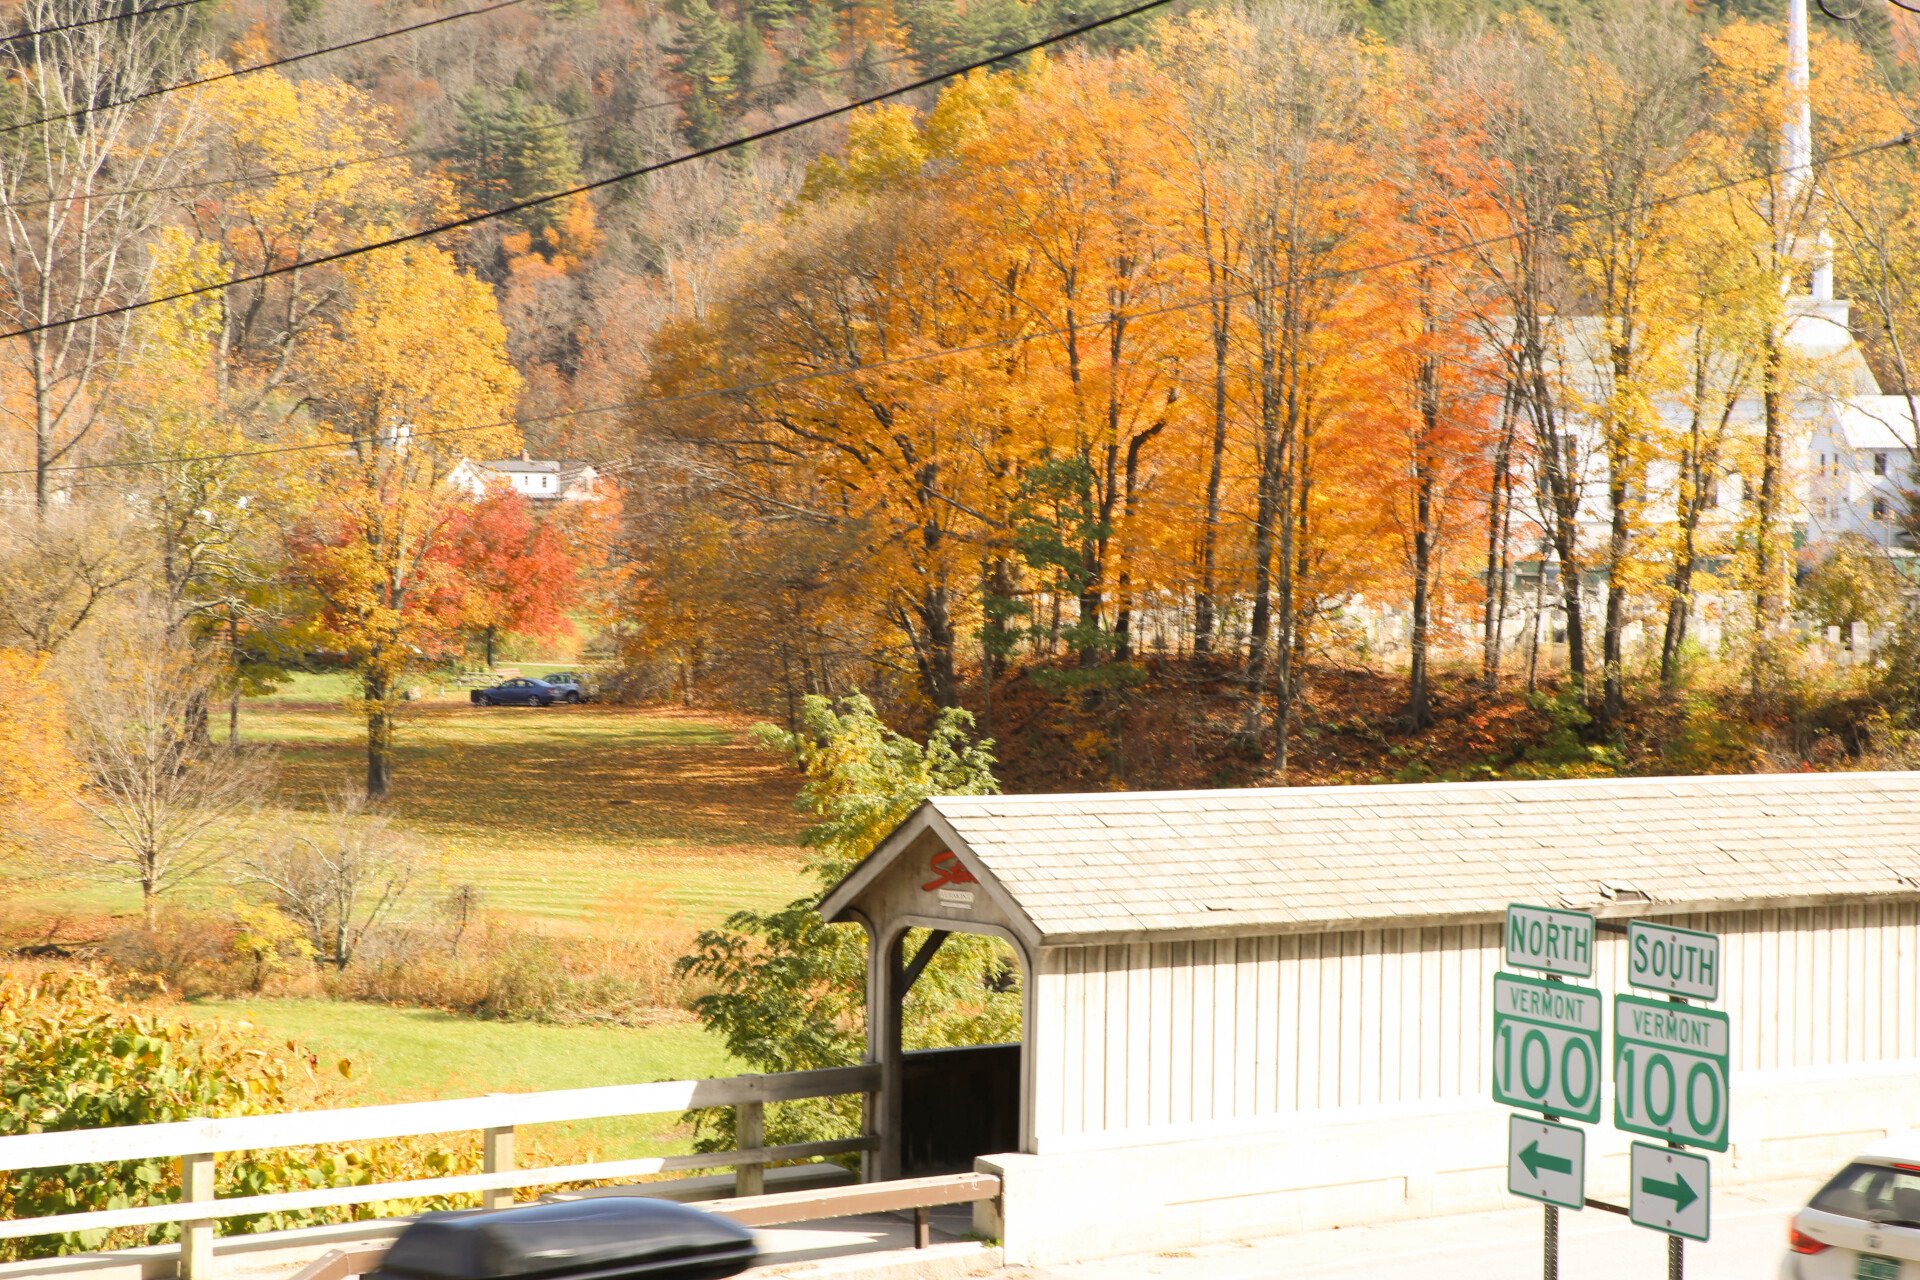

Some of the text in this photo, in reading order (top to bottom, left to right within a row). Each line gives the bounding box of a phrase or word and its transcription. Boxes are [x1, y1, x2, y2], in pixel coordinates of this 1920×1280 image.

[1512, 915, 1587, 963] NORTH
[1634, 934, 1713, 986] SOUTH
[1511, 987, 1585, 1022] VERMONT
[1633, 1010, 1711, 1047] VERMONT
[1501, 1025, 1592, 1107] 100
[1624, 1050, 1719, 1135] 100
